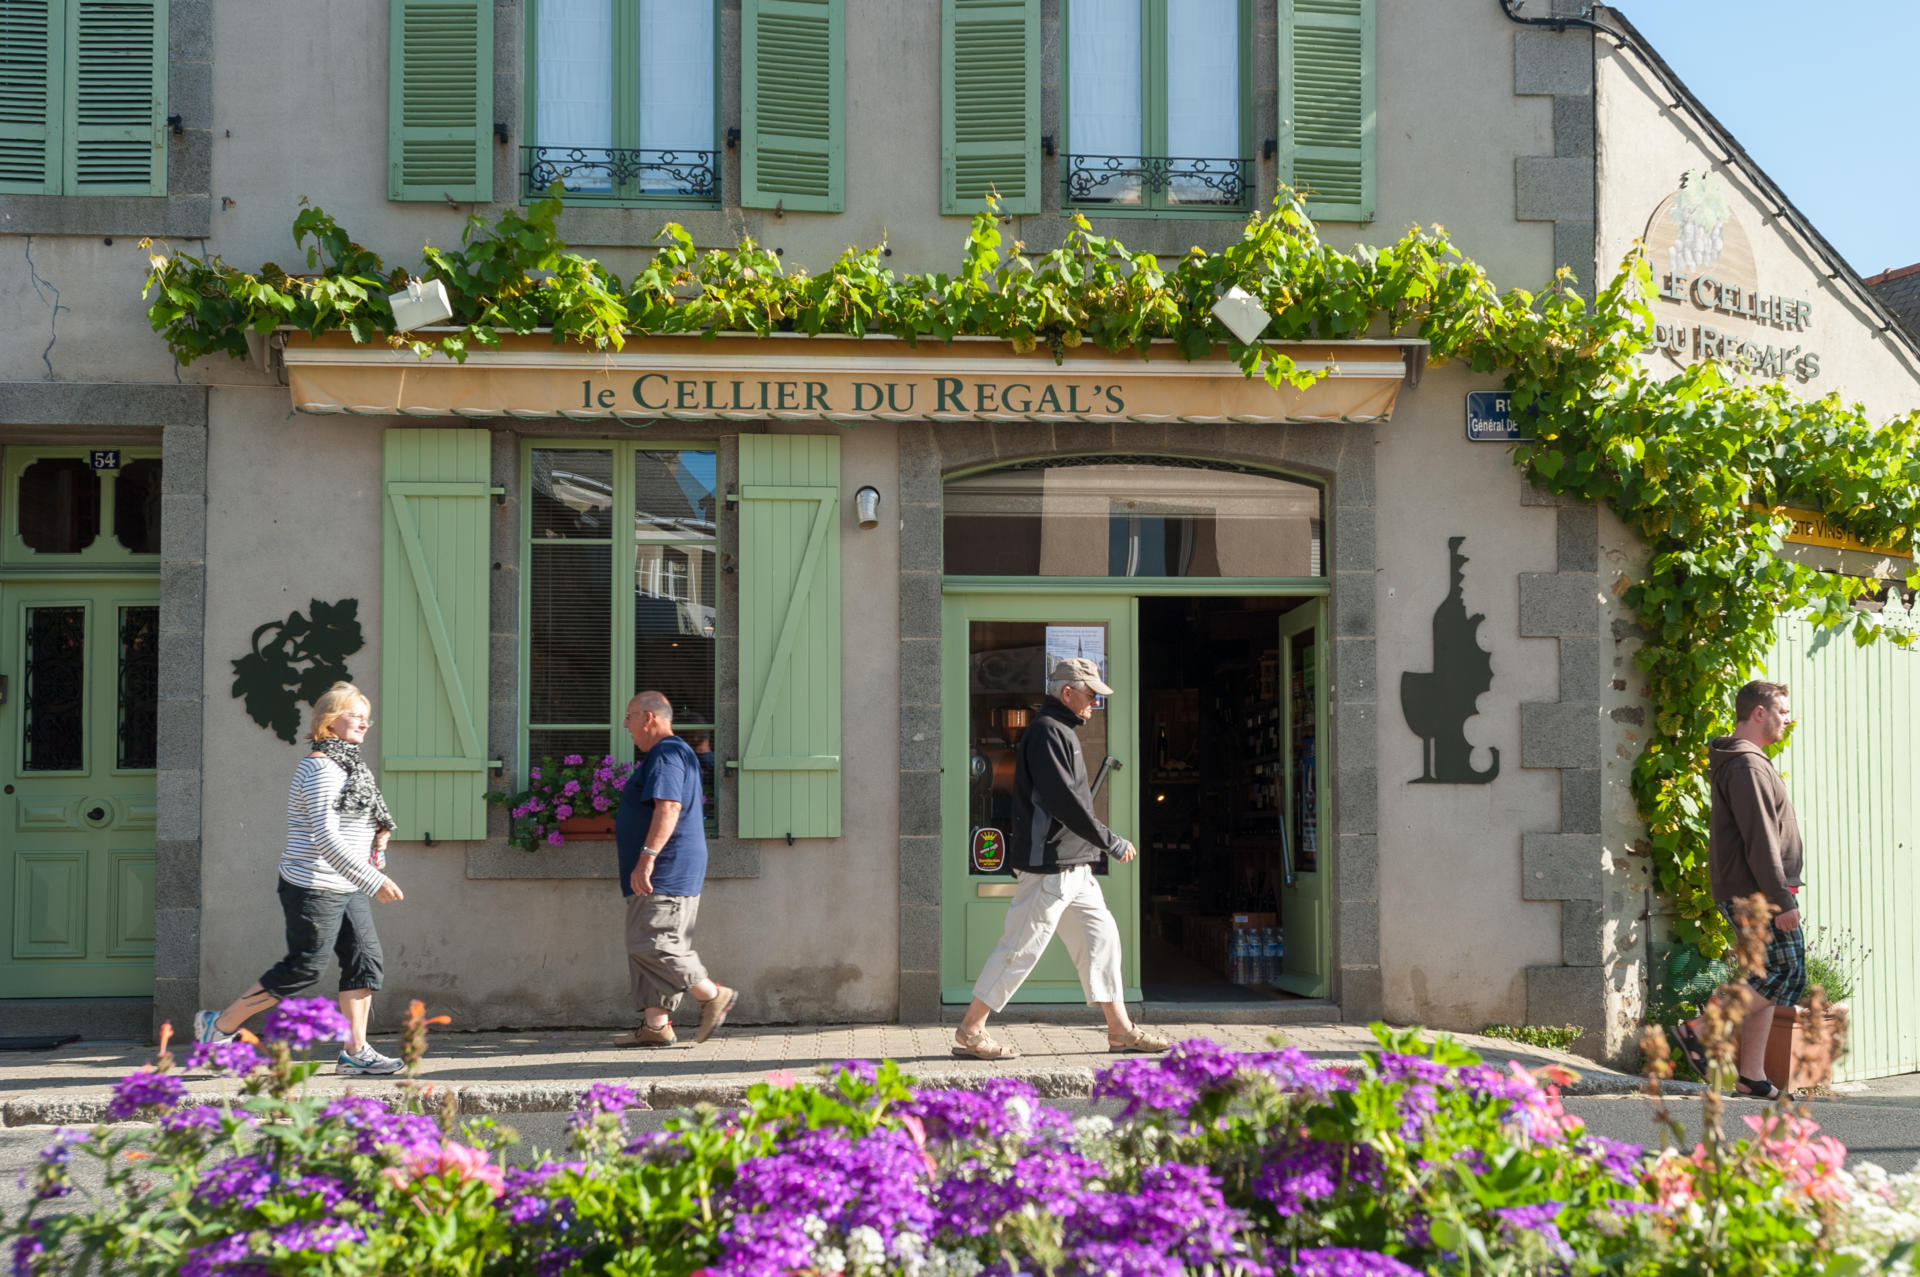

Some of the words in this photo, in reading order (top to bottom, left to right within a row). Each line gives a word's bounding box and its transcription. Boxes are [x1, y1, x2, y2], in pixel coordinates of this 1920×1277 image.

[1651, 261, 1688, 301] LE
[1696, 274, 1812, 327] CELLIER
[1653, 322, 1688, 352] DU
[1699, 325, 1820, 379] REGAL'S
[582, 380, 616, 408] le
[632, 373, 832, 411] CELLIER
[851, 382, 918, 412] DU
[933, 377, 1125, 414] REGAL'S
[1471, 418, 1505, 432] Général
[95, 452, 116, 468] 54
